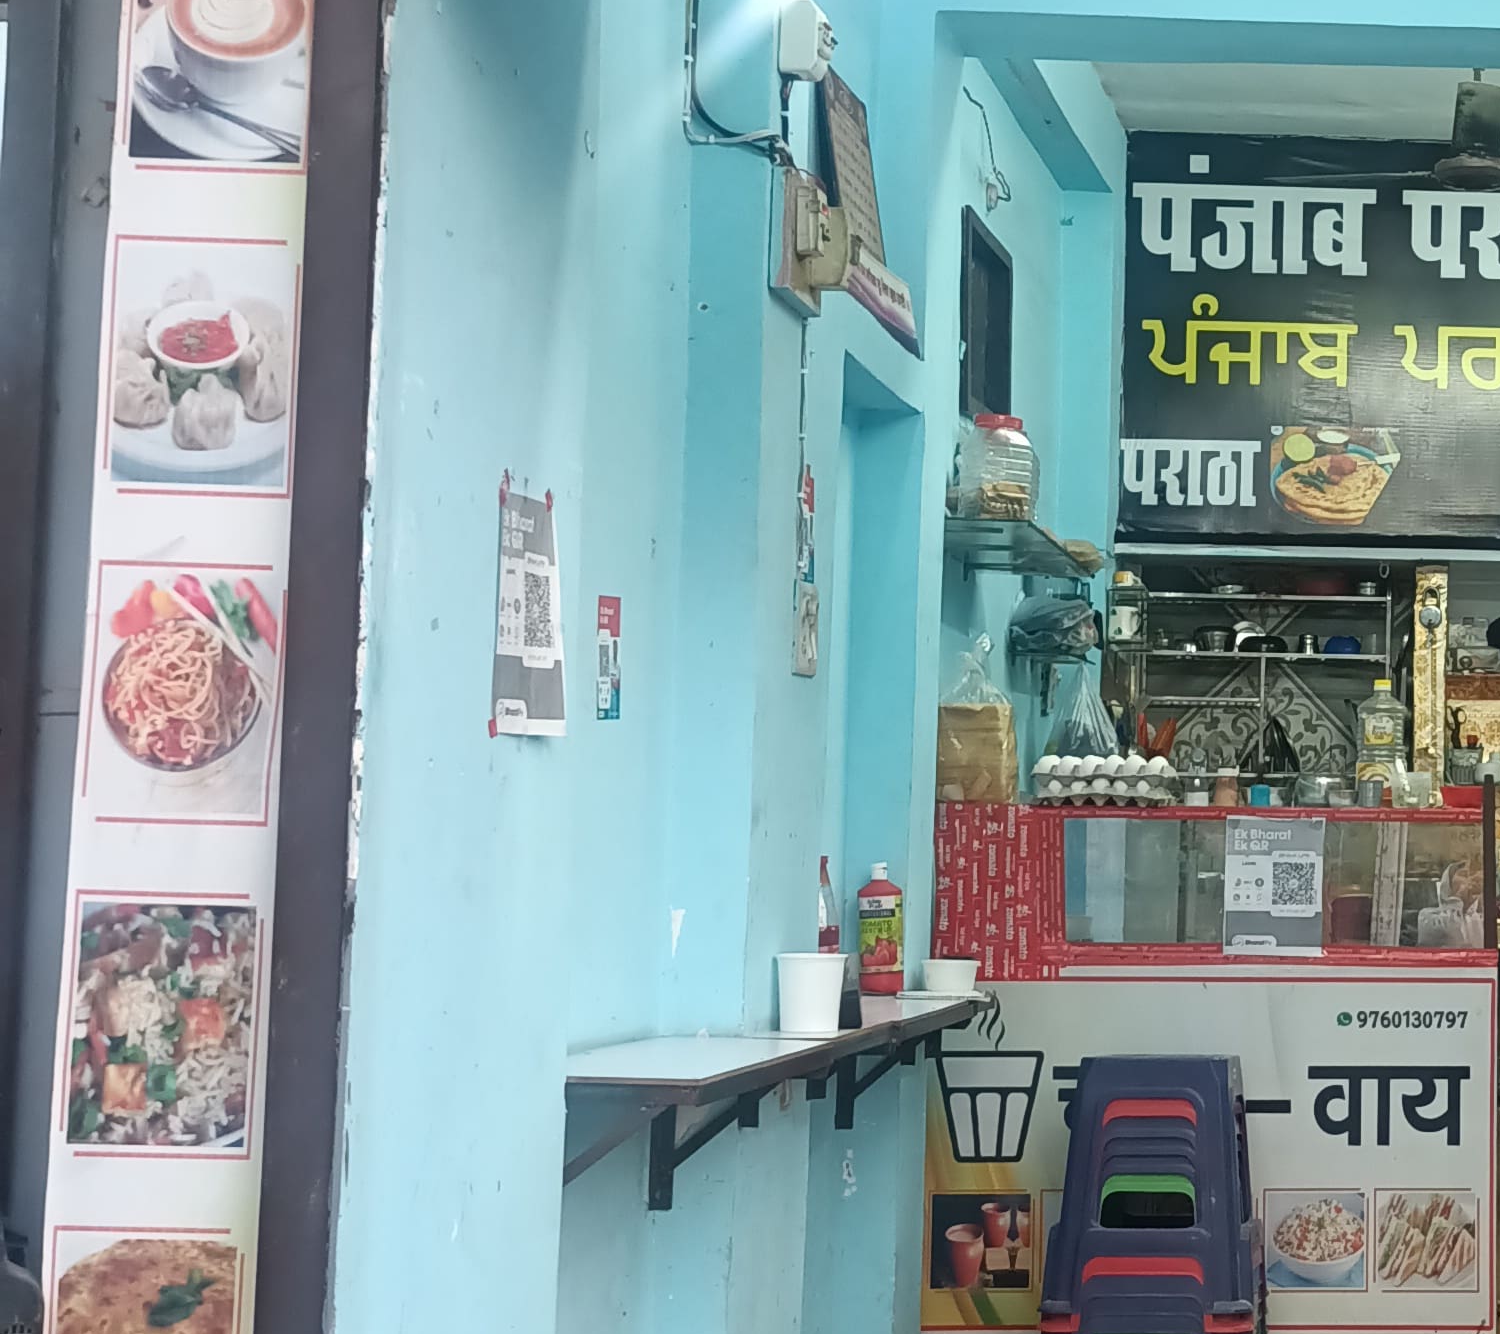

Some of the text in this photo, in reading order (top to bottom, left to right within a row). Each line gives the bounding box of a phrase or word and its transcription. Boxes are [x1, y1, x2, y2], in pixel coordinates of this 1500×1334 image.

[1132, 155, 1377, 276] पंजाब
[1142, 293, 1358, 386] ਪੰਜਾਬ
[1120, 437, 1262, 508] पराठा
[1234, 828, 1292, 841] Ek Bharat
[1234, 840, 1269, 851] Ek QR
[1357, 1010, 1469, 1030] 9760130797
[1308, 1065, 1470, 1146] वाय
